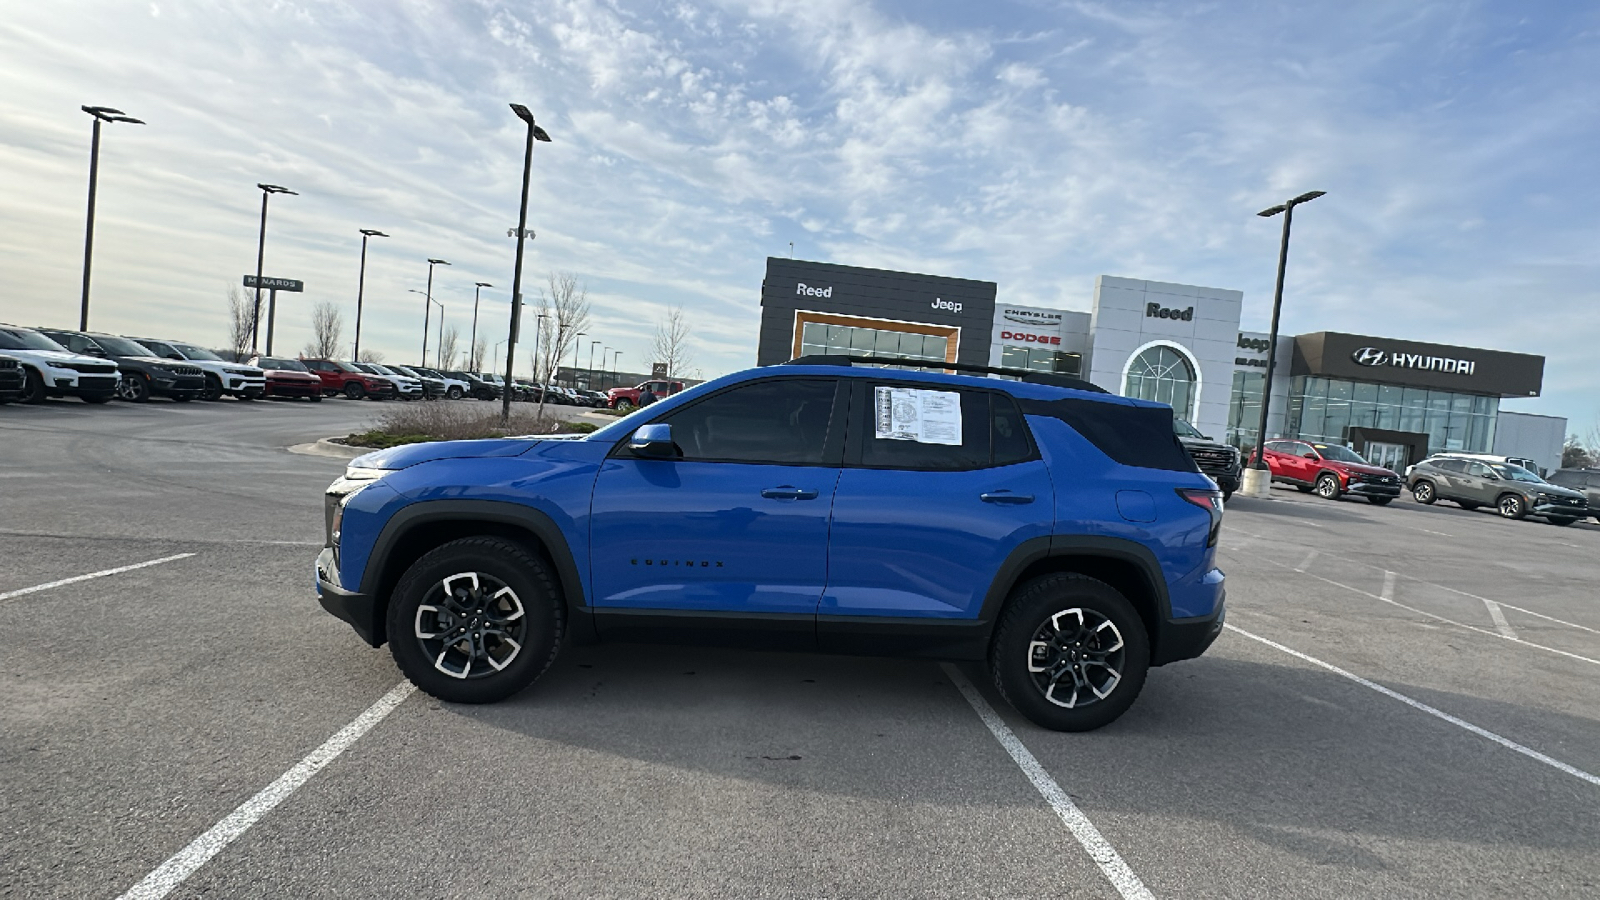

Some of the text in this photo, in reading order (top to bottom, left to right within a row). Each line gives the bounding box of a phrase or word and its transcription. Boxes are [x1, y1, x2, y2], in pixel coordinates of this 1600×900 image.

[247, 277, 296, 288] MNARDS
[796, 282, 832, 299] Reed
[931, 297, 963, 313] Jeep
[1146, 301, 1194, 322] Reed
[1004, 309, 1062, 320] CHRYSLER
[1000, 331, 1062, 346] DODGE
[1391, 352, 1476, 376] HYUNDAI
[630, 559, 724, 567] EQUINOX
